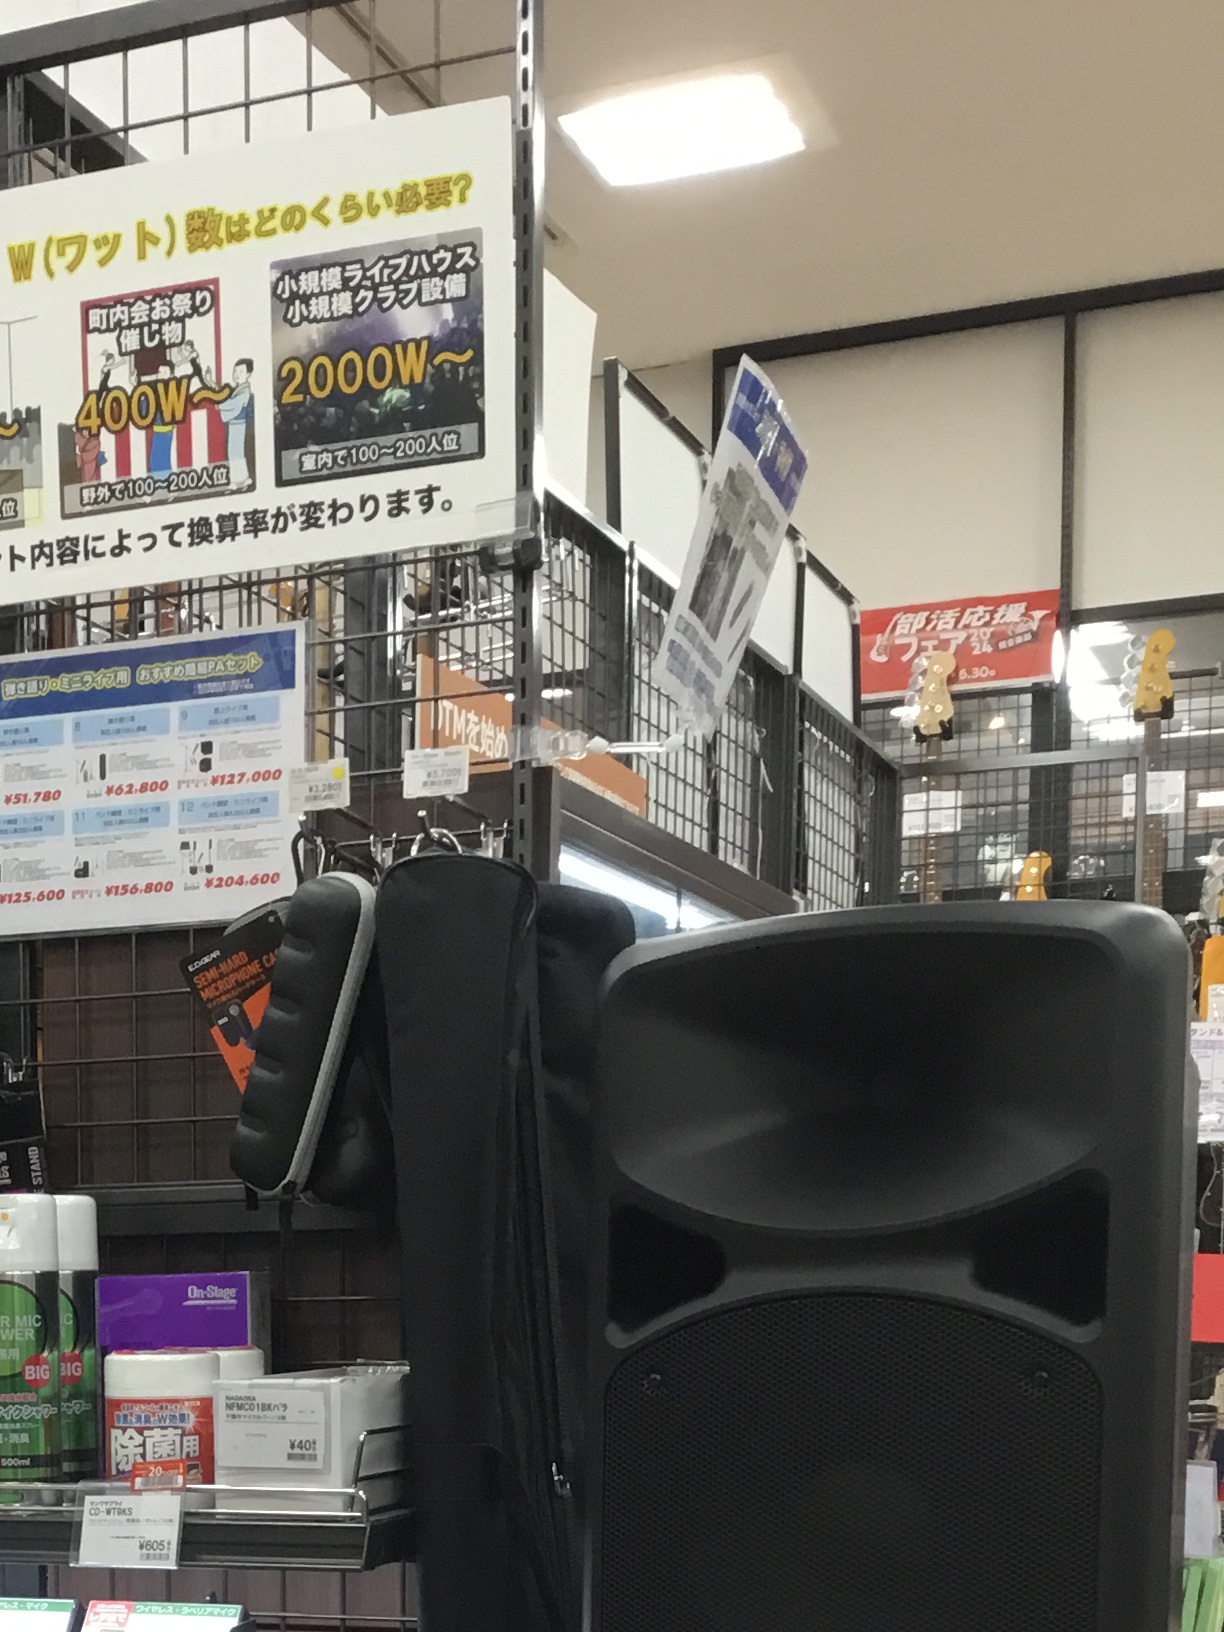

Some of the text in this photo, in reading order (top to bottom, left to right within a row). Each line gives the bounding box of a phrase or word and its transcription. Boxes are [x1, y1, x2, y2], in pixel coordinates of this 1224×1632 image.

[276, 244, 476, 299] 小規模ライブハウス
[87, 286, 214, 333] 町内会お祭り
[286, 271, 466, 325] 小規模クラブ設備
[894, 602, 1028, 636] 部活応援
[969, 627, 993, 642] 20
[971, 641, 993, 655] 24
[193, 950, 249, 988] SEMI-HARD
[199, 959, 264, 1001] MICROPHONE
[27, 1146, 43, 1186] STAND
[187, 1285, 238, 1300] On-Stage
[15, 1315, 42, 1327] MIC
[25, 1365, 50, 1380] BIG
[110, 1428, 200, 1476] 除菌用
[289, 1438, 312, 1451] ¥40
[1, 1457, 30, 1466] 500ml
[138, 1540, 166, 1552] ¥605
